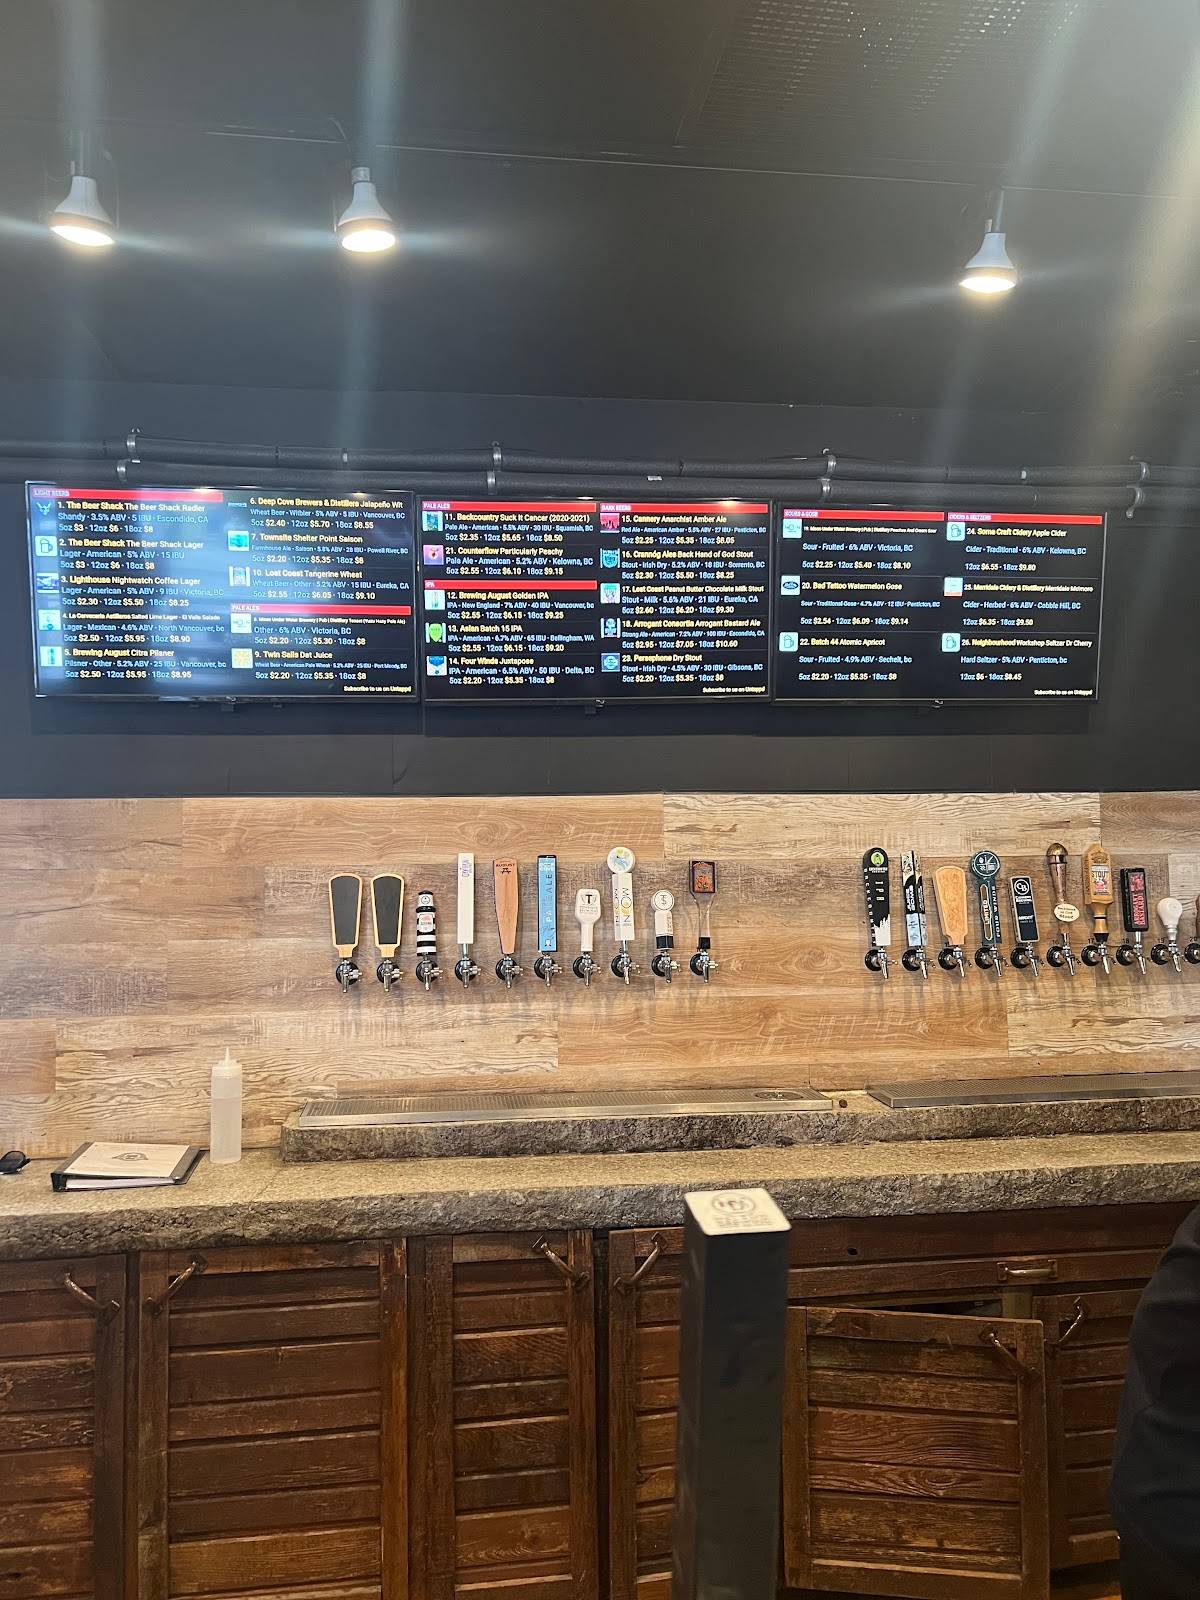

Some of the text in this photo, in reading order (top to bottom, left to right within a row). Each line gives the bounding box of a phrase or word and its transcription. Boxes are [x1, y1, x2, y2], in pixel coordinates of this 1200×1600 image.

[58, 514, 85, 522] Shandy
[157, 516, 197, 524] Escondido,
[457, 514, 499, 522] Backcountry
[549, 515, 590, 523] (2020-2021)
[184, 541, 203, 549] Lager
[500, 548, 537, 556] Particularly
[70, 576, 111, 584] Lighthouse
[112, 577, 153, 585] Nightwatch
[181, 578, 200, 586] Lager
[459, 592, 486, 600] Brewing
[488, 592, 511, 600] August
[73, 649, 102, 657] Brewing
[499, 658, 534, 666] Juxtapose
